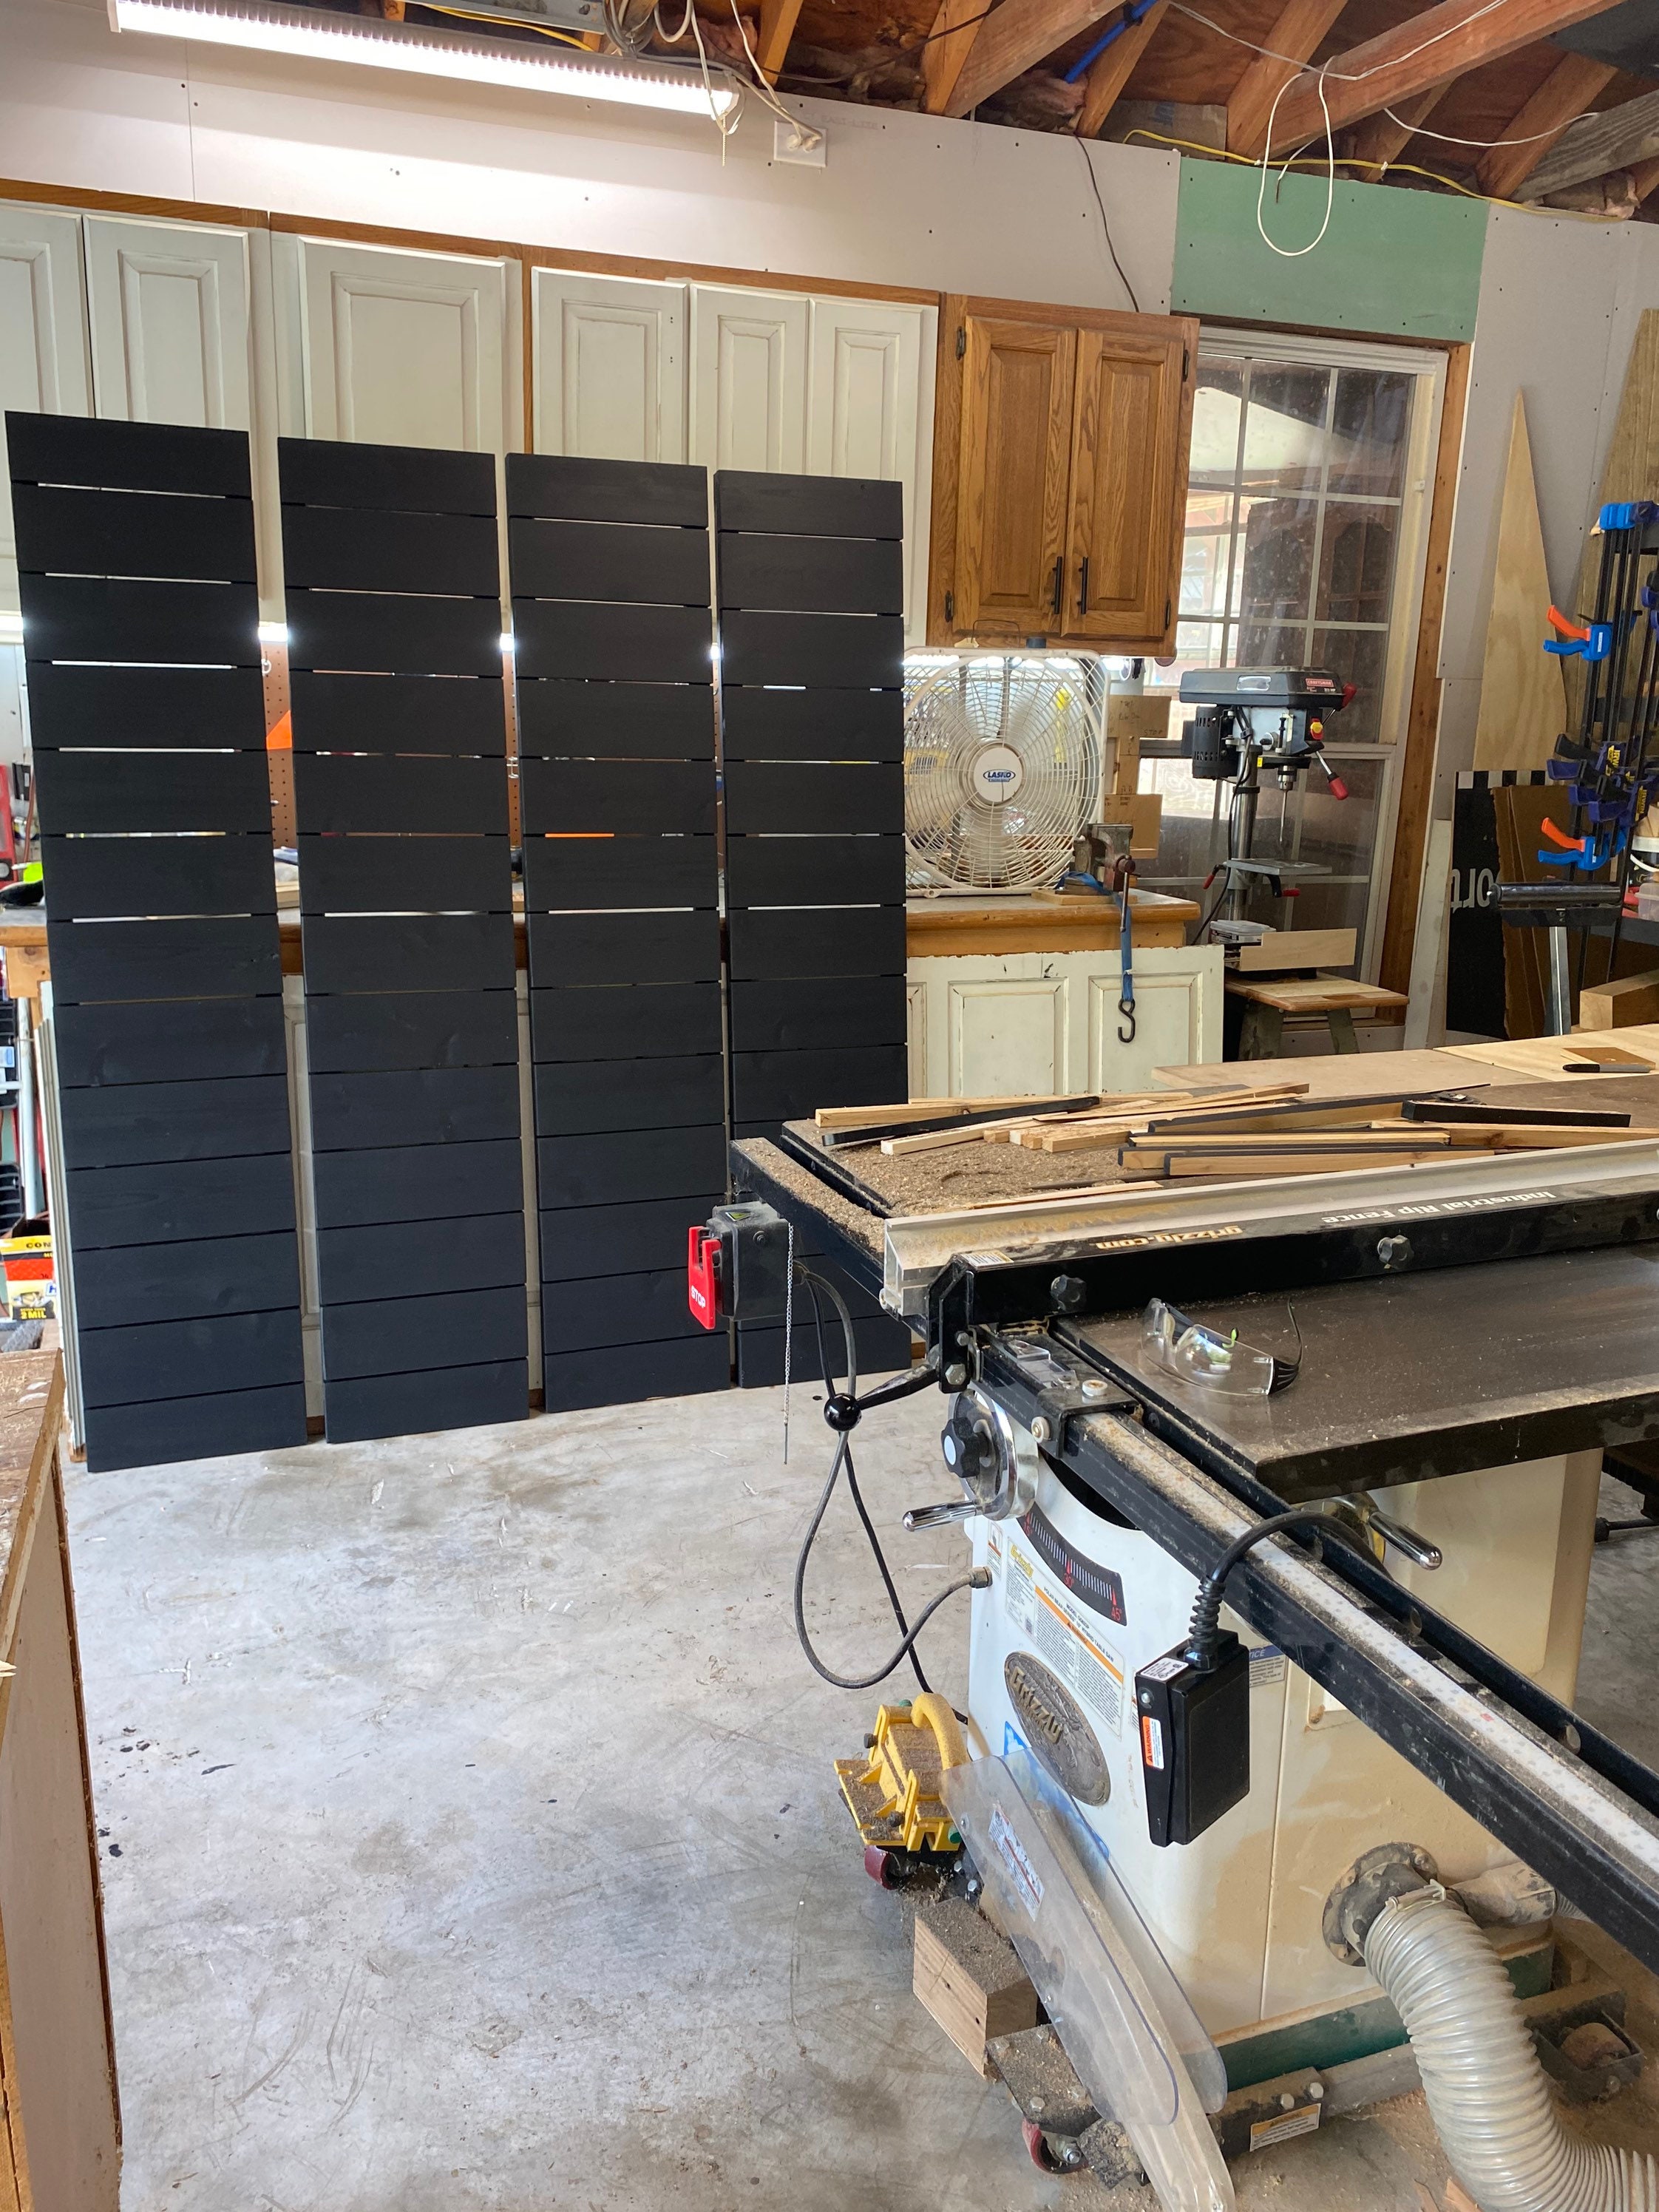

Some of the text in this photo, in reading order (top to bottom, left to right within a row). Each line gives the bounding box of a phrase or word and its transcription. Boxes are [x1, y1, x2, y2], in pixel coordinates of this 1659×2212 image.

[1451, 868, 1495, 914] ort
[1321, 1191, 1557, 1224] Industrial Rip Fence
[1095, 1225, 1244, 1250] grizzly.com
[691, 1285, 706, 1309] STOP
[27, 1310, 47, 1319] MIL
[1249, 1649, 1266, 1658] TICE
[1010, 1666, 1063, 1744] Grizzly
